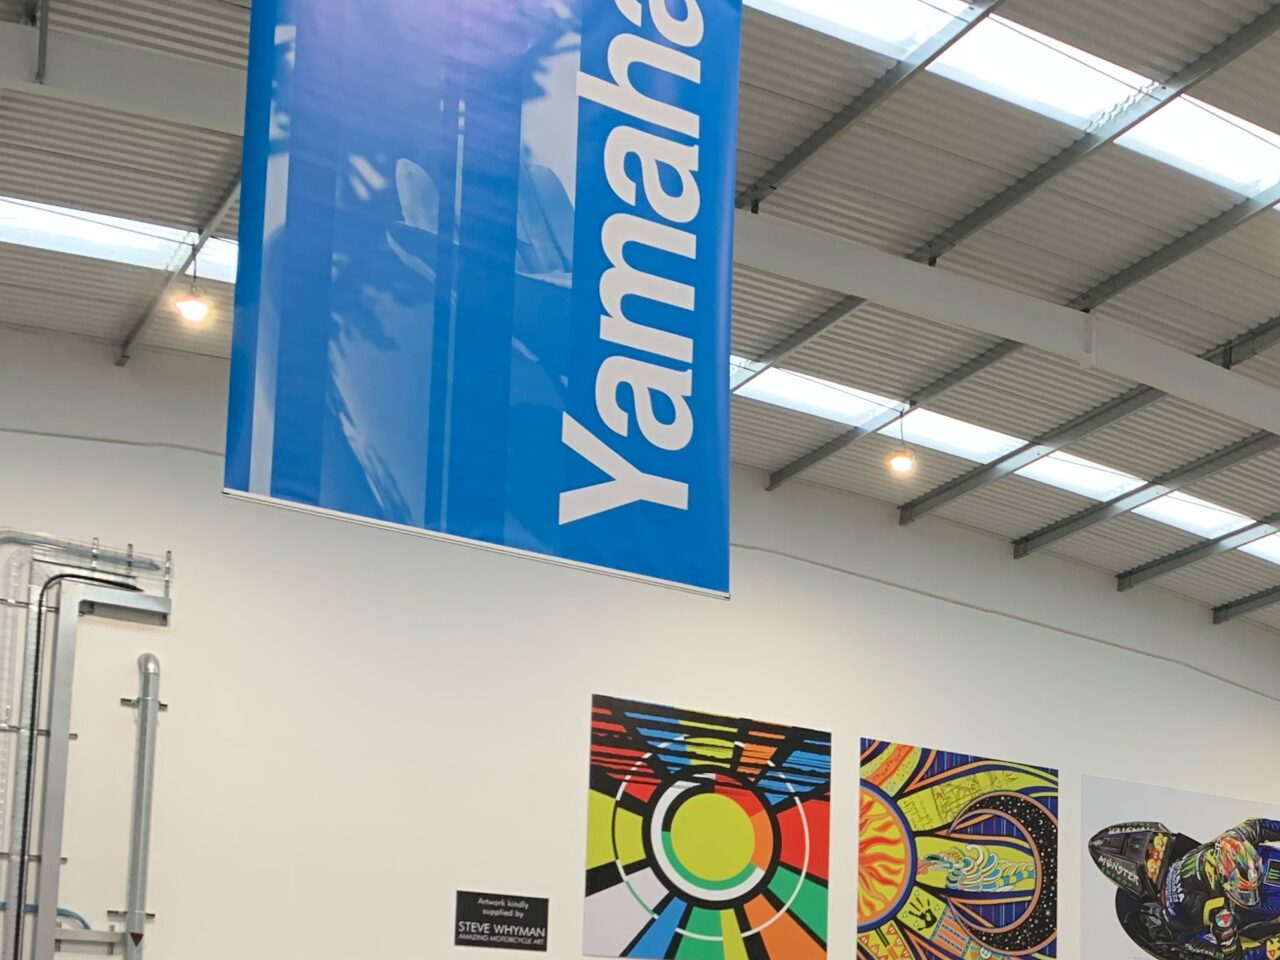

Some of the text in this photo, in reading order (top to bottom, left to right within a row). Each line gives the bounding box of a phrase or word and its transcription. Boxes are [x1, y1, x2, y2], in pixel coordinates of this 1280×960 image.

[477, 897, 529, 910] Artwork kindly
[482, 908, 524, 919] supplied by
[458, 920, 545, 938] STEVE WHYMAN
[457, 933, 488, 941] AMAZING
[489, 936, 532, 945] MOTORCYCLE
